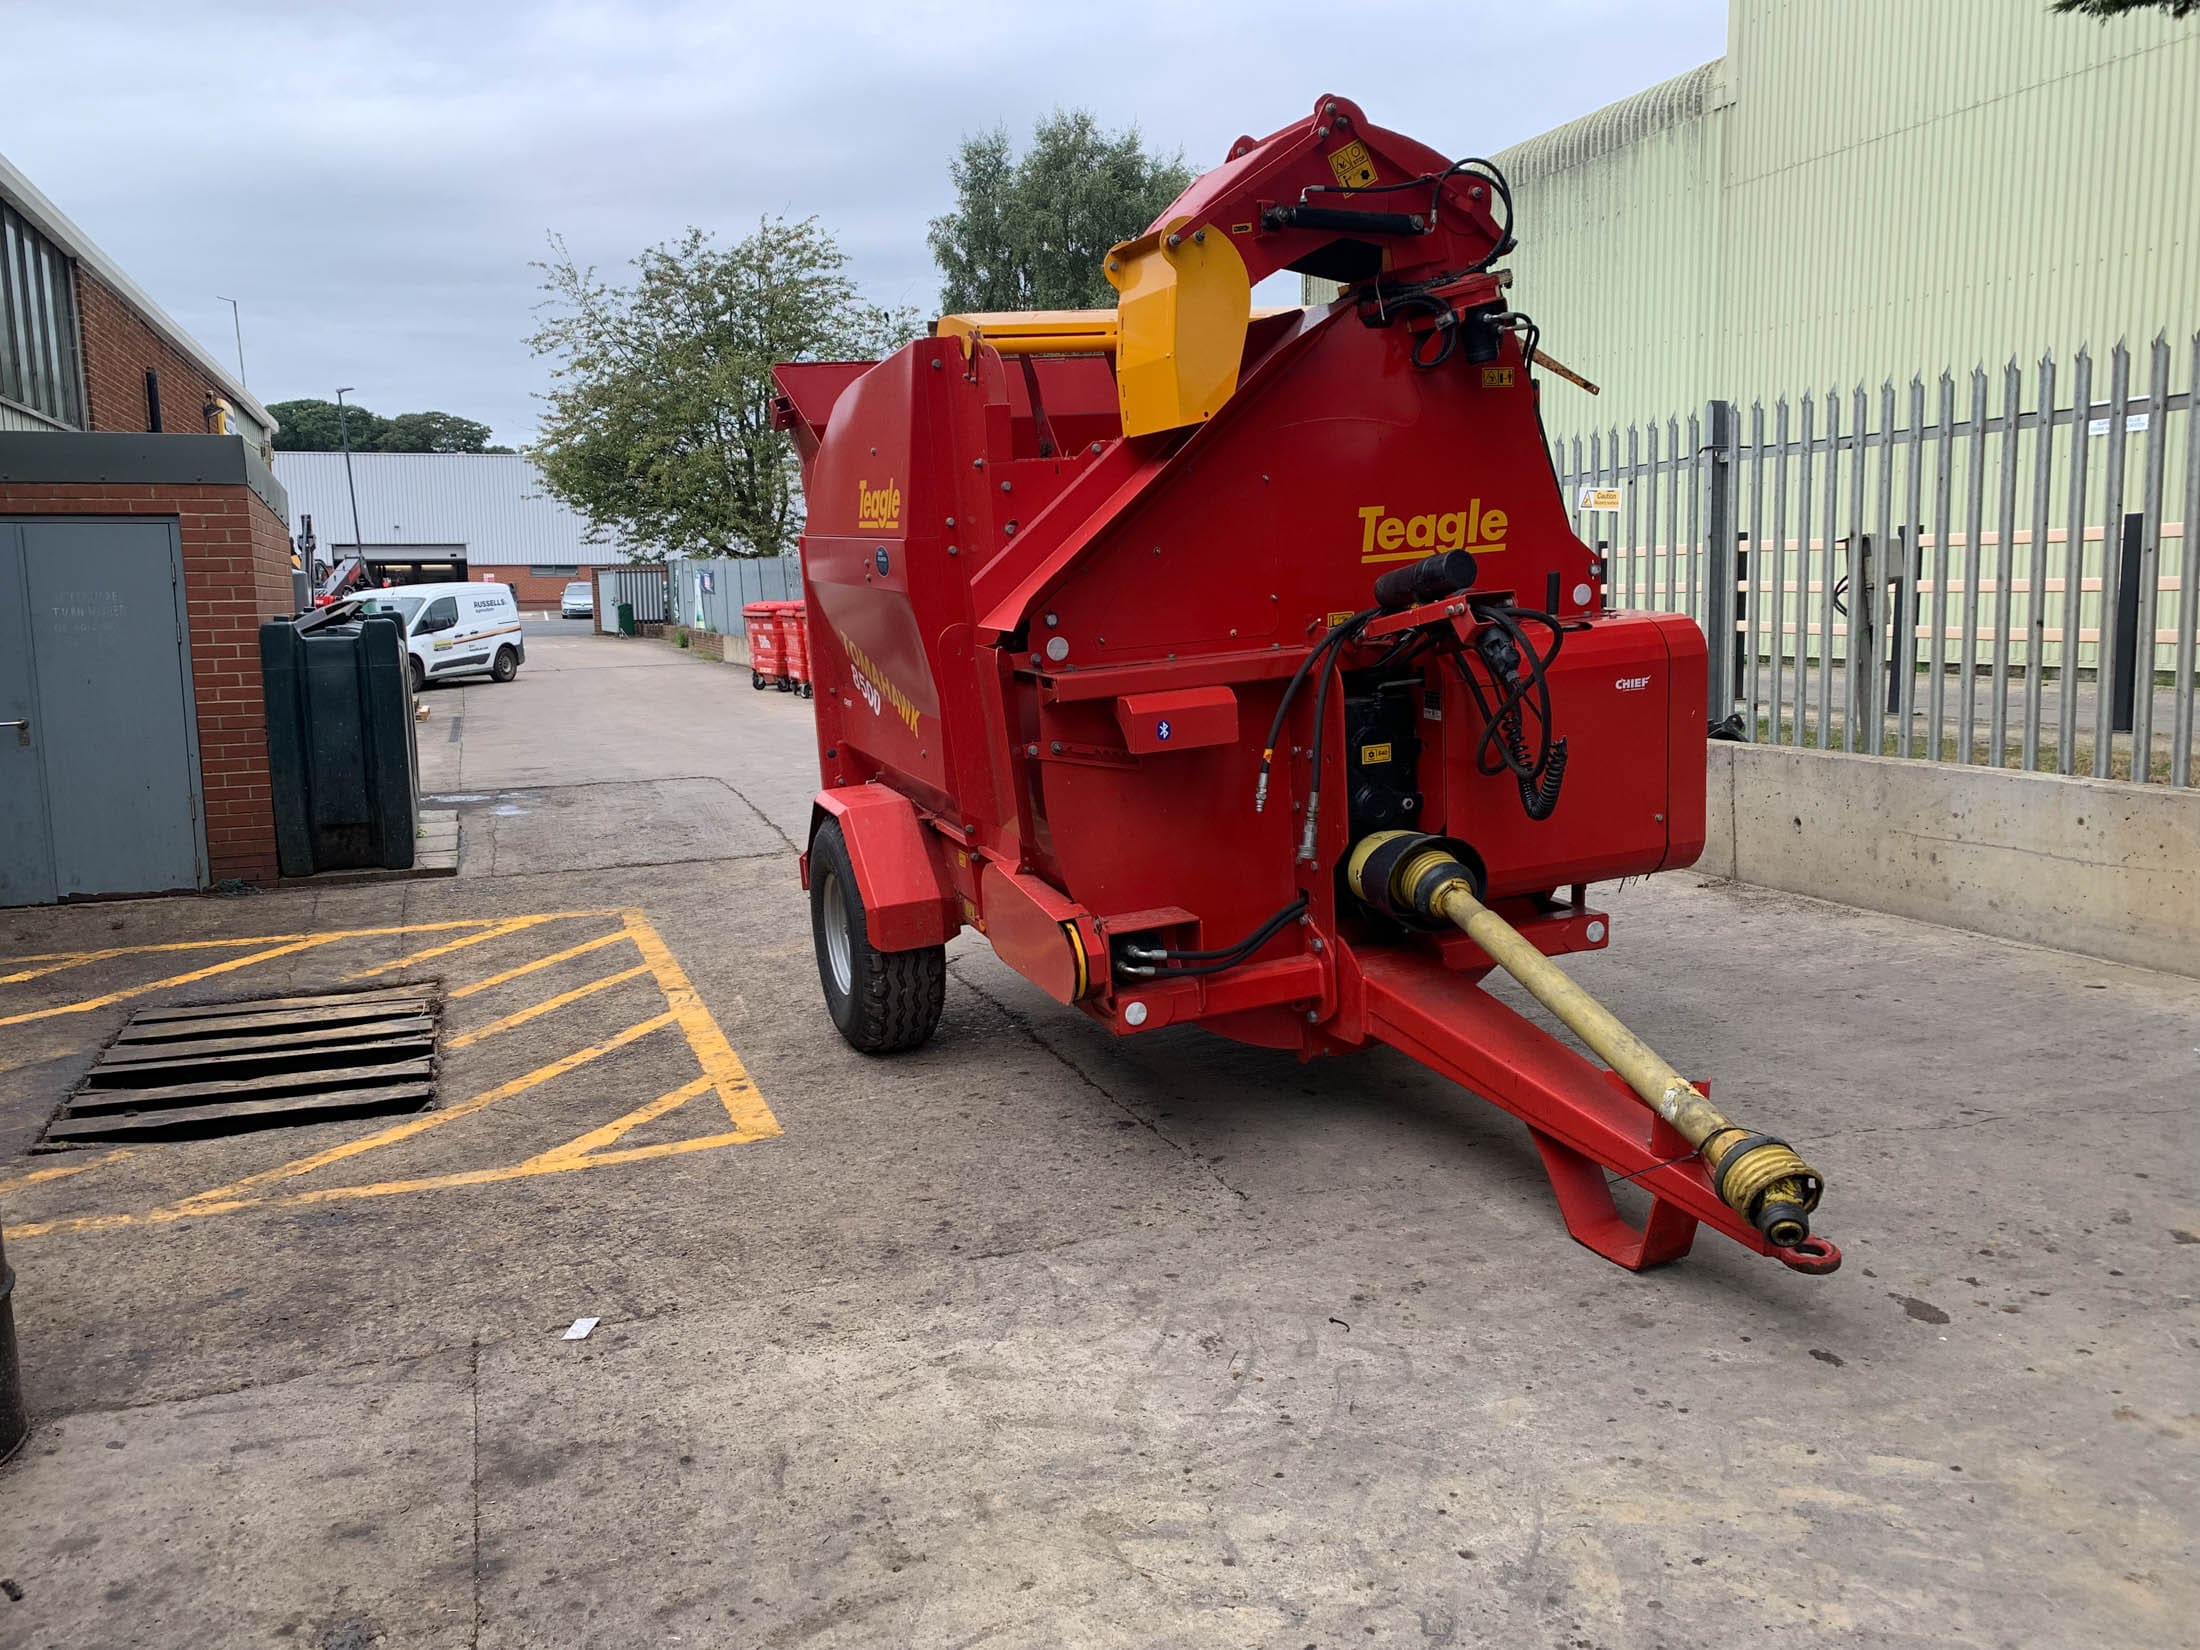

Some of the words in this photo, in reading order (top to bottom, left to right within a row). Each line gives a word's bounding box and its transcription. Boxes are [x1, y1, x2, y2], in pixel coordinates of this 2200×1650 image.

[859, 477, 900, 528] Teagle
[1358, 498, 1508, 556] Teagle
[474, 599, 505, 608] RUSSELLS
[840, 630, 920, 739] TOMAHAWK
[851, 663, 880, 716] 8500
[1615, 675, 1651, 690] CHIEF
